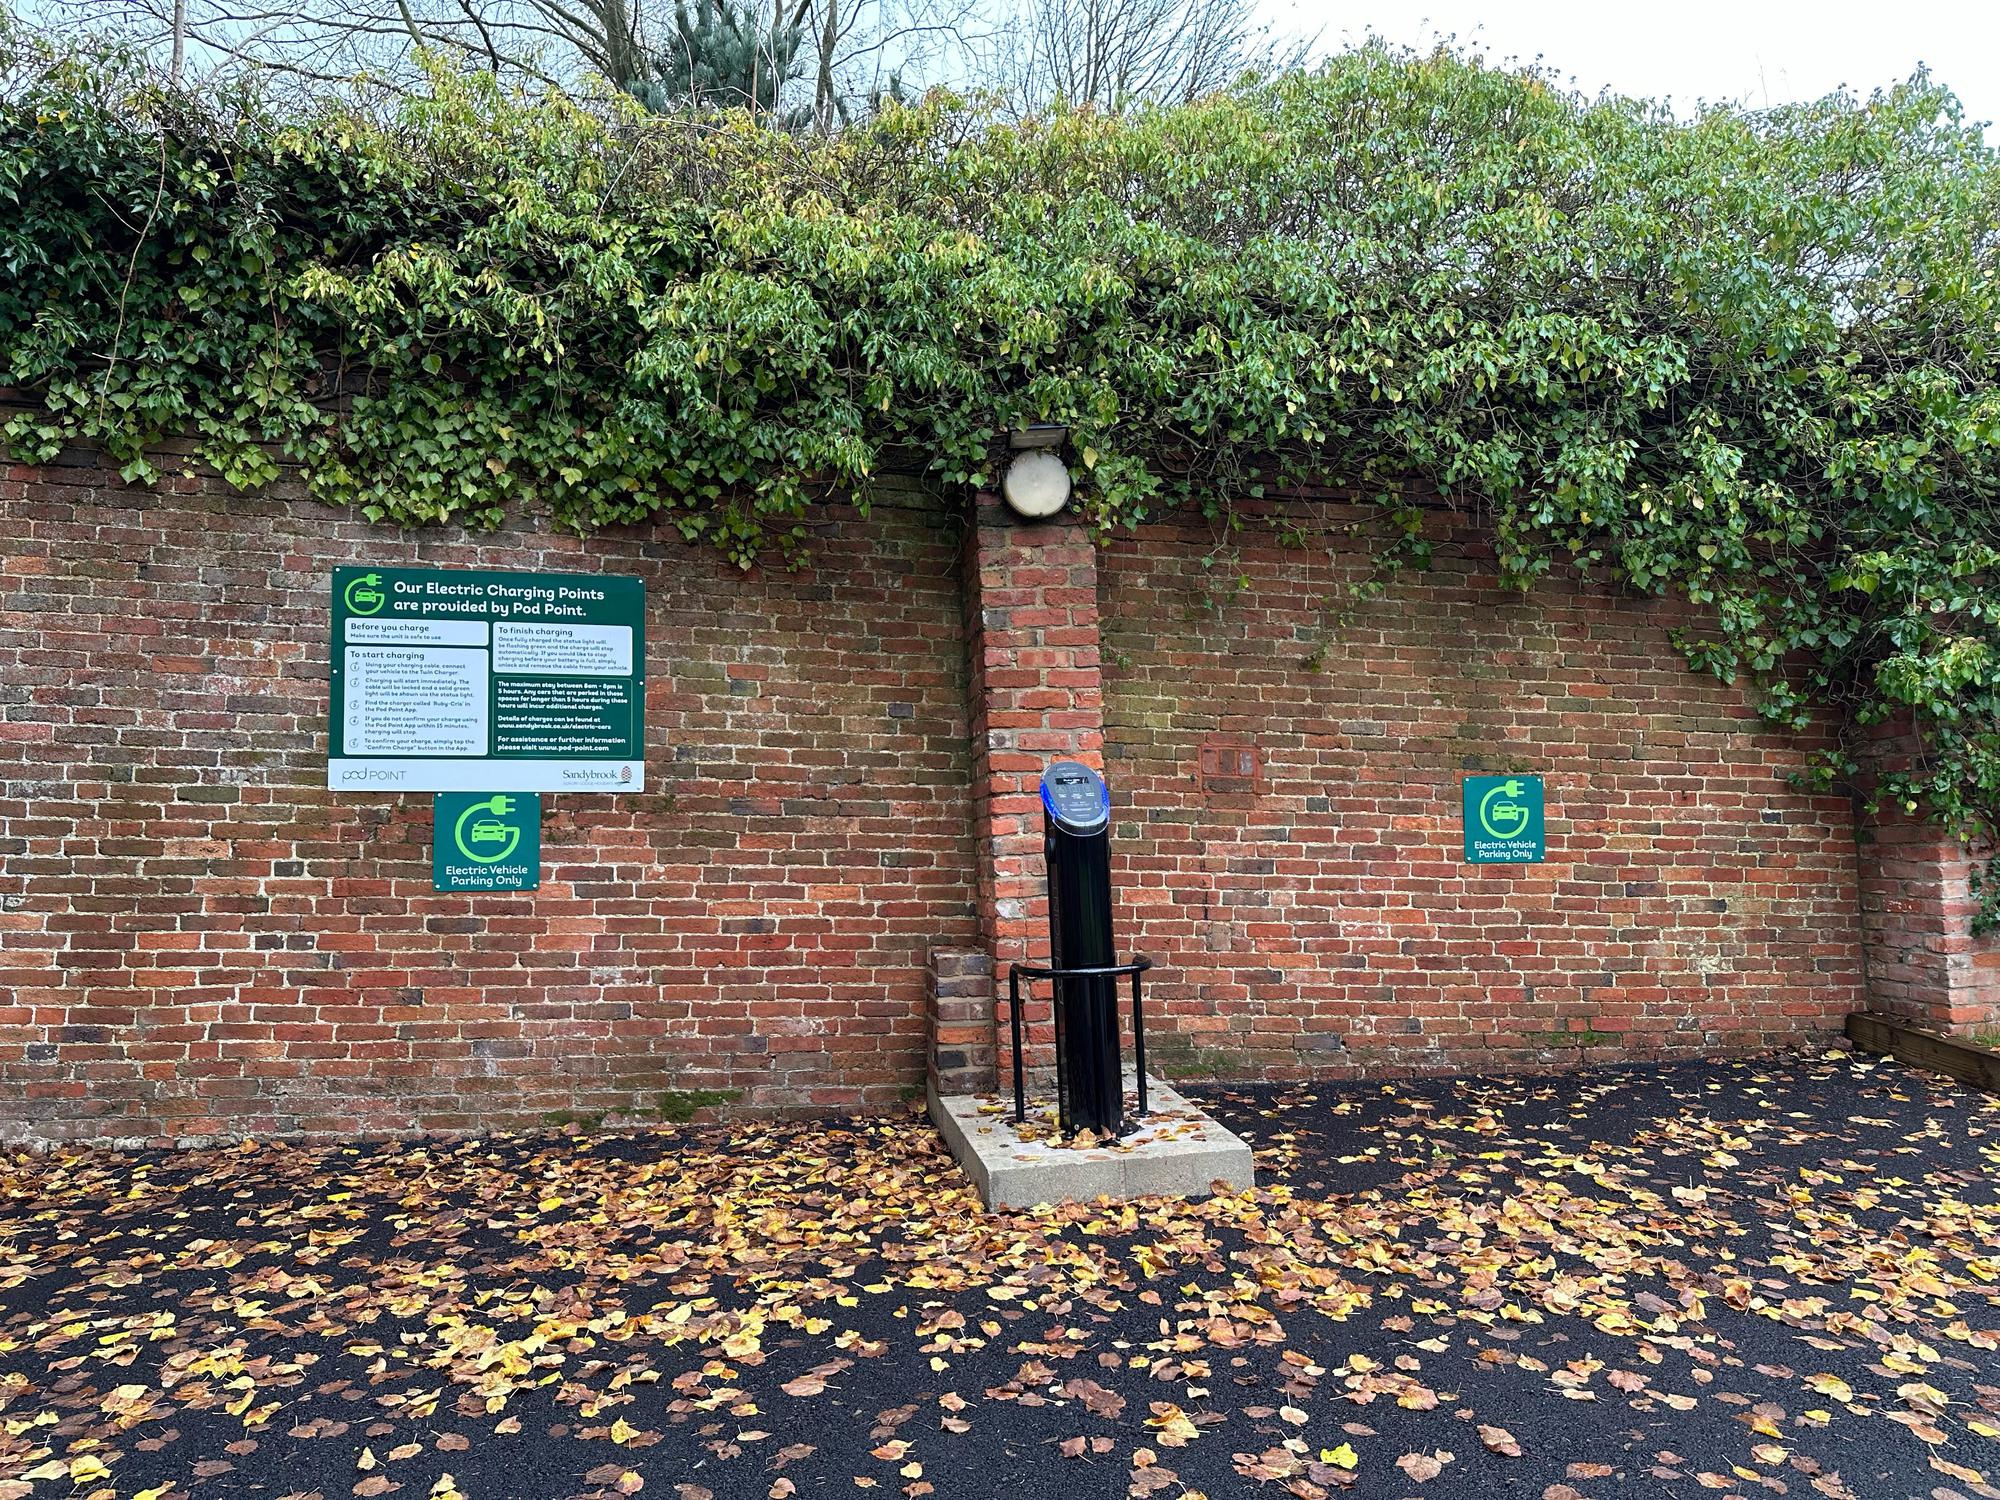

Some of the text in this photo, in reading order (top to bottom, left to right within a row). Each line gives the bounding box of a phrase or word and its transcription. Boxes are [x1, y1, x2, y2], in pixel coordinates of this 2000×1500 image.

[394, 582, 604, 602] Our Electric Charging Points
[394, 600, 586, 617] are provided by Pod Point.
[400, 624, 429, 633] charge
[536, 628, 573, 637] charging
[386, 652, 425, 660] charging
[342, 767, 406, 784] pod POINT
[563, 770, 618, 781] Sandybrook
[1474, 840, 1536, 849] Electric Vehicle
[1479, 849, 1532, 860] Parking Only
[446, 865, 528, 875] Electric Vehicle
[451, 875, 522, 887] Parking Only
